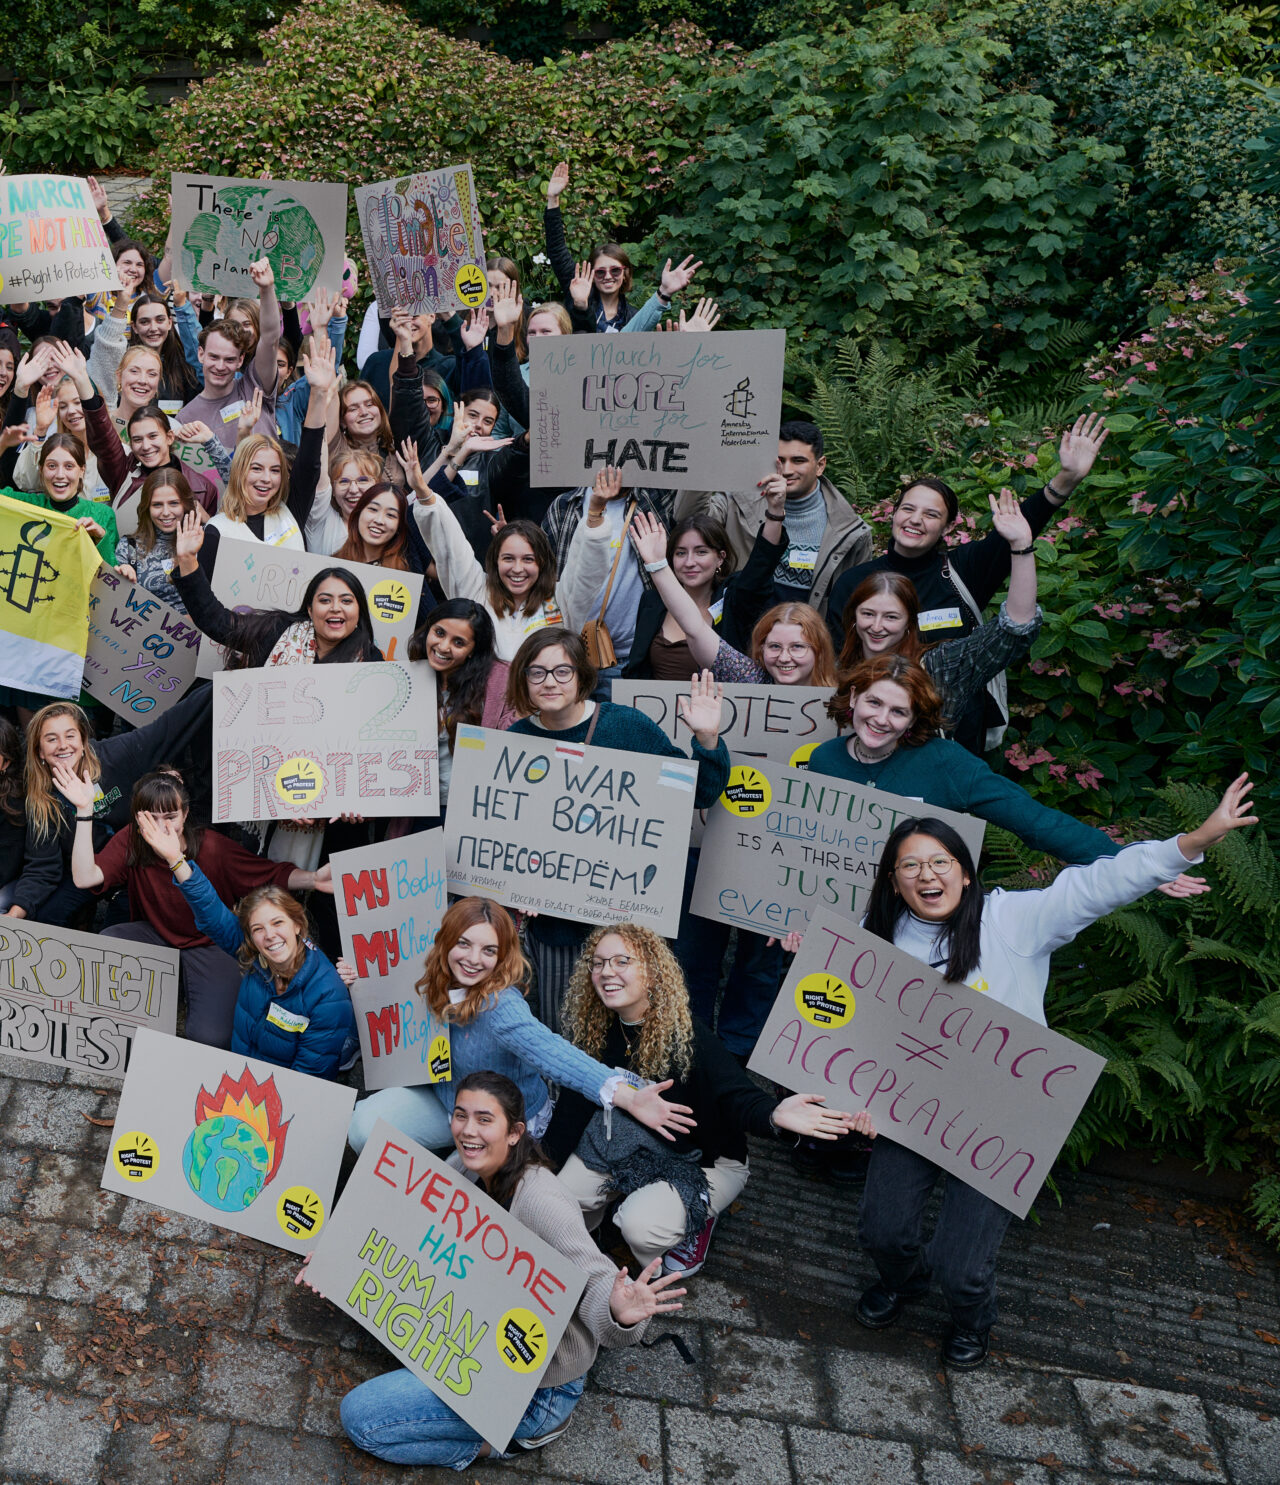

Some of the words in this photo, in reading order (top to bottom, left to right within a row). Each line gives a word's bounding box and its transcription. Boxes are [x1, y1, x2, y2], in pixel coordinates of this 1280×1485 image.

[7, 178, 86, 216] MARCH
[186, 183, 253, 220] There
[269, 211, 280, 222] is
[28, 217, 67, 255] NOT
[71, 216, 108, 249] HATE
[241, 228, 279, 249] NO
[64, 261, 99, 282] Protest
[213, 258, 250, 280] plan
[280, 255, 303, 280] B
[544, 347, 577, 376] We
[591, 341, 662, 380] March
[677, 342, 733, 390] for
[536, 388, 548, 413] the
[583, 372, 685, 412] HOPE
[600, 411, 640, 430] not
[653, 410, 708, 438] for
[721, 420, 752, 430] Amnesty
[721, 429, 770, 437] International
[584, 438, 690, 473] HATE
[125, 588, 161, 622] WE
[110, 608, 143, 637] WE
[143, 633, 174, 659] GO
[121, 652, 181, 693] YES
[110, 680, 156, 713] NO
[219, 677, 325, 728] YES
[345, 662, 417, 741] 2
[493, 746, 551, 784] NO
[564, 759, 640, 807] WAR
[727, 787, 744, 797] RIGHT
[738, 792, 763, 801] PROTEST
[472, 785, 529, 821] НЕТ
[552, 796, 665, 849] ВОЙНЕ
[766, 811, 886, 857] anywher
[737, 832, 762, 850] IS
[771, 841, 784, 857] A
[801, 846, 880, 880] THREAT
[391, 857, 444, 910] Body
[510, 893, 541, 908] РОССИЯ
[544, 899, 576, 914] БУДЕТ
[399, 916, 440, 960] Choic
[52, 999, 78, 1014] THE
[805, 994, 824, 1002] RIGHT
[816, 1001, 844, 1013] PROTEST
[120, 1152, 136, 1160] RIGHT
[130, 1157, 152, 1166] PROTEST
[285, 1202, 302, 1213] RIGHT
[292, 1210, 314, 1228] PROTEST
[418, 1224, 474, 1279] HAS
[358, 1228, 489, 1356] HUMAN
[346, 1268, 483, 1397] RIGHTS
